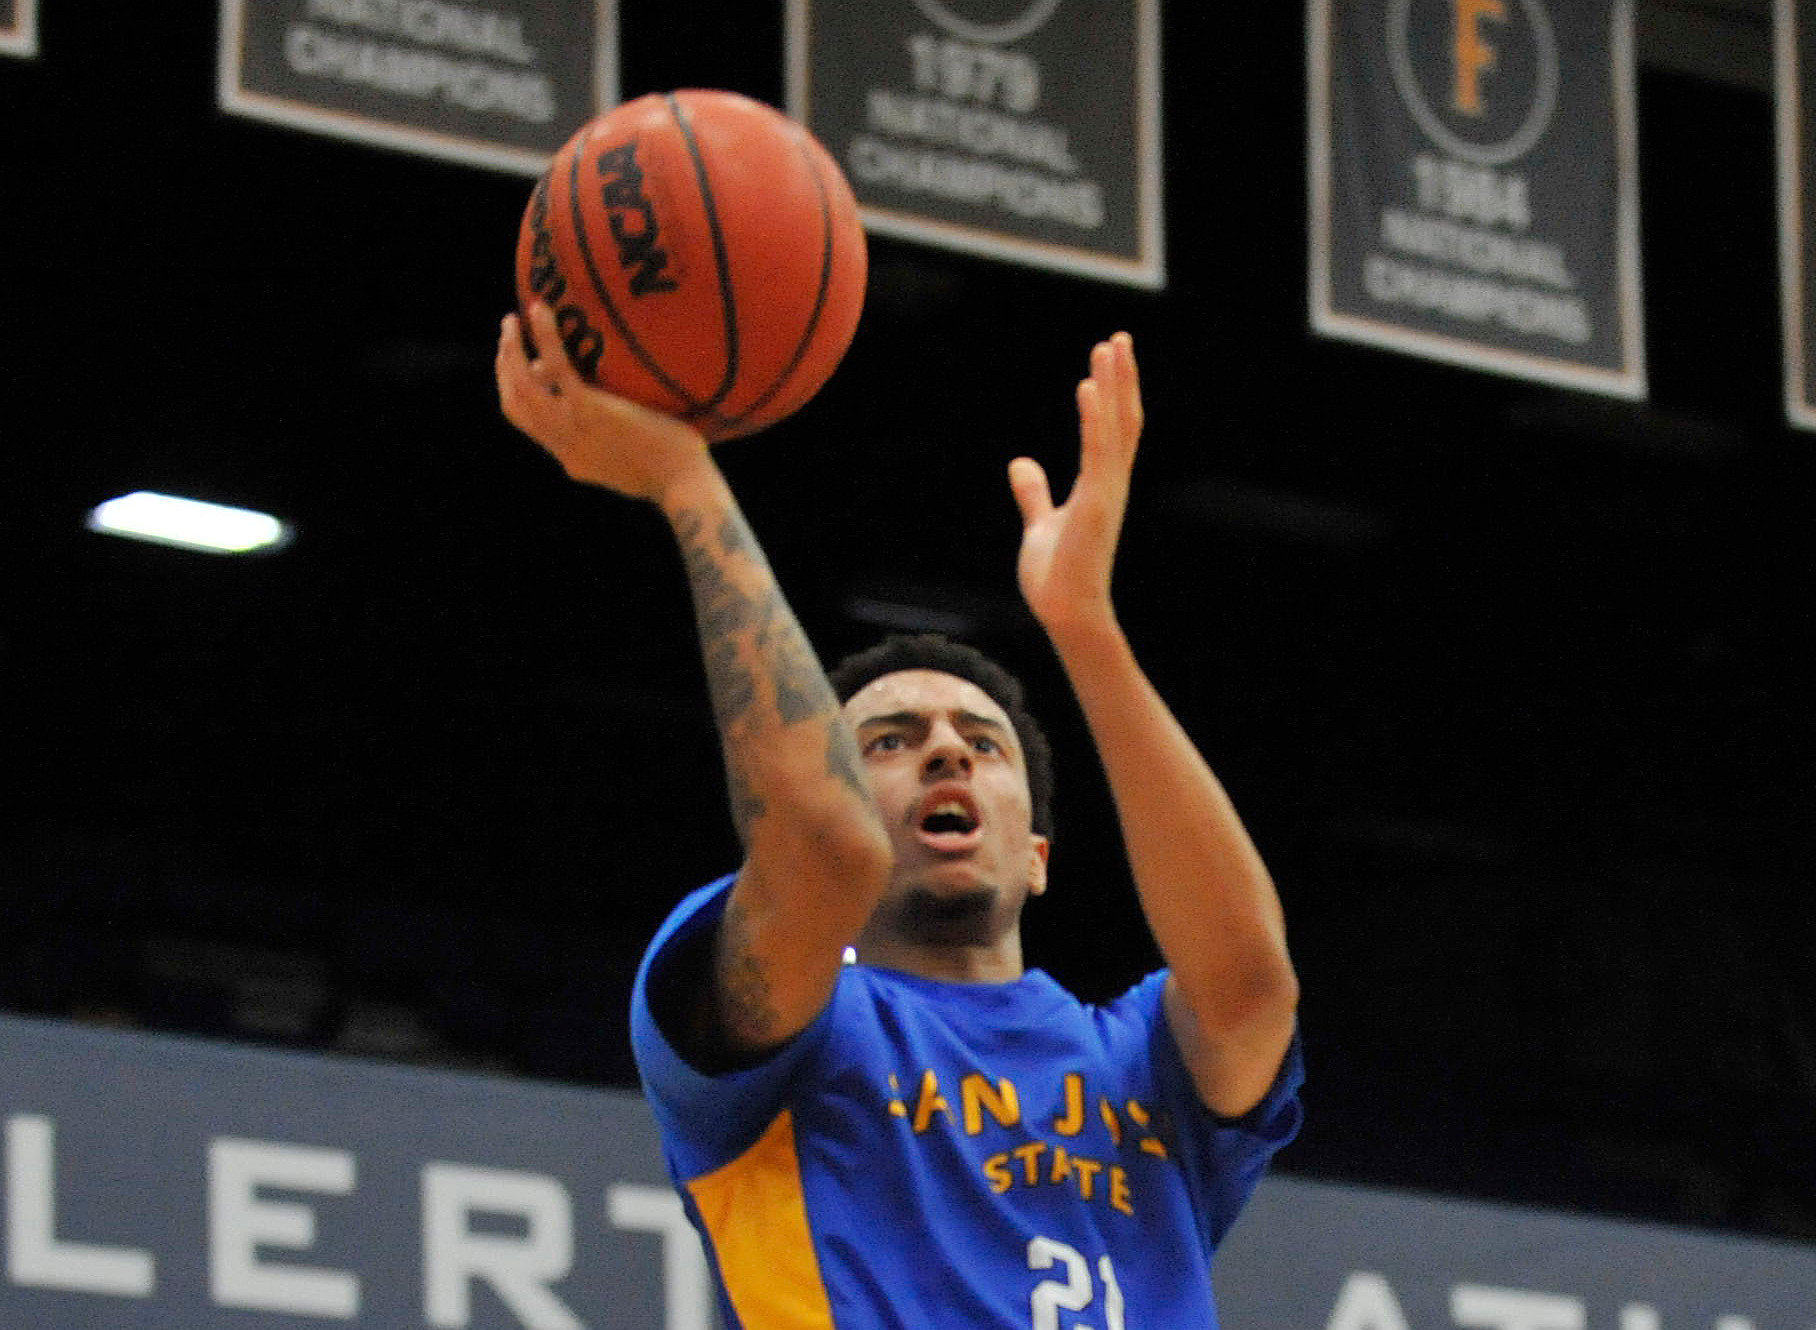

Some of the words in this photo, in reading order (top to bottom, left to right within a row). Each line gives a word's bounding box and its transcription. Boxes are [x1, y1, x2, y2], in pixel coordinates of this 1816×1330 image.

[283, 26, 555, 124] CHAMPIONS
[908, 34, 1040, 113] 1979
[868, 89, 1079, 175] NATIONAL
[850, 134, 1104, 229] CHAMPIONS
[1380, 207, 1574, 290] NATIONAL
[1361, 252, 1592, 345] CHAMPIONS
[982, 1141, 1135, 1217] STATE
